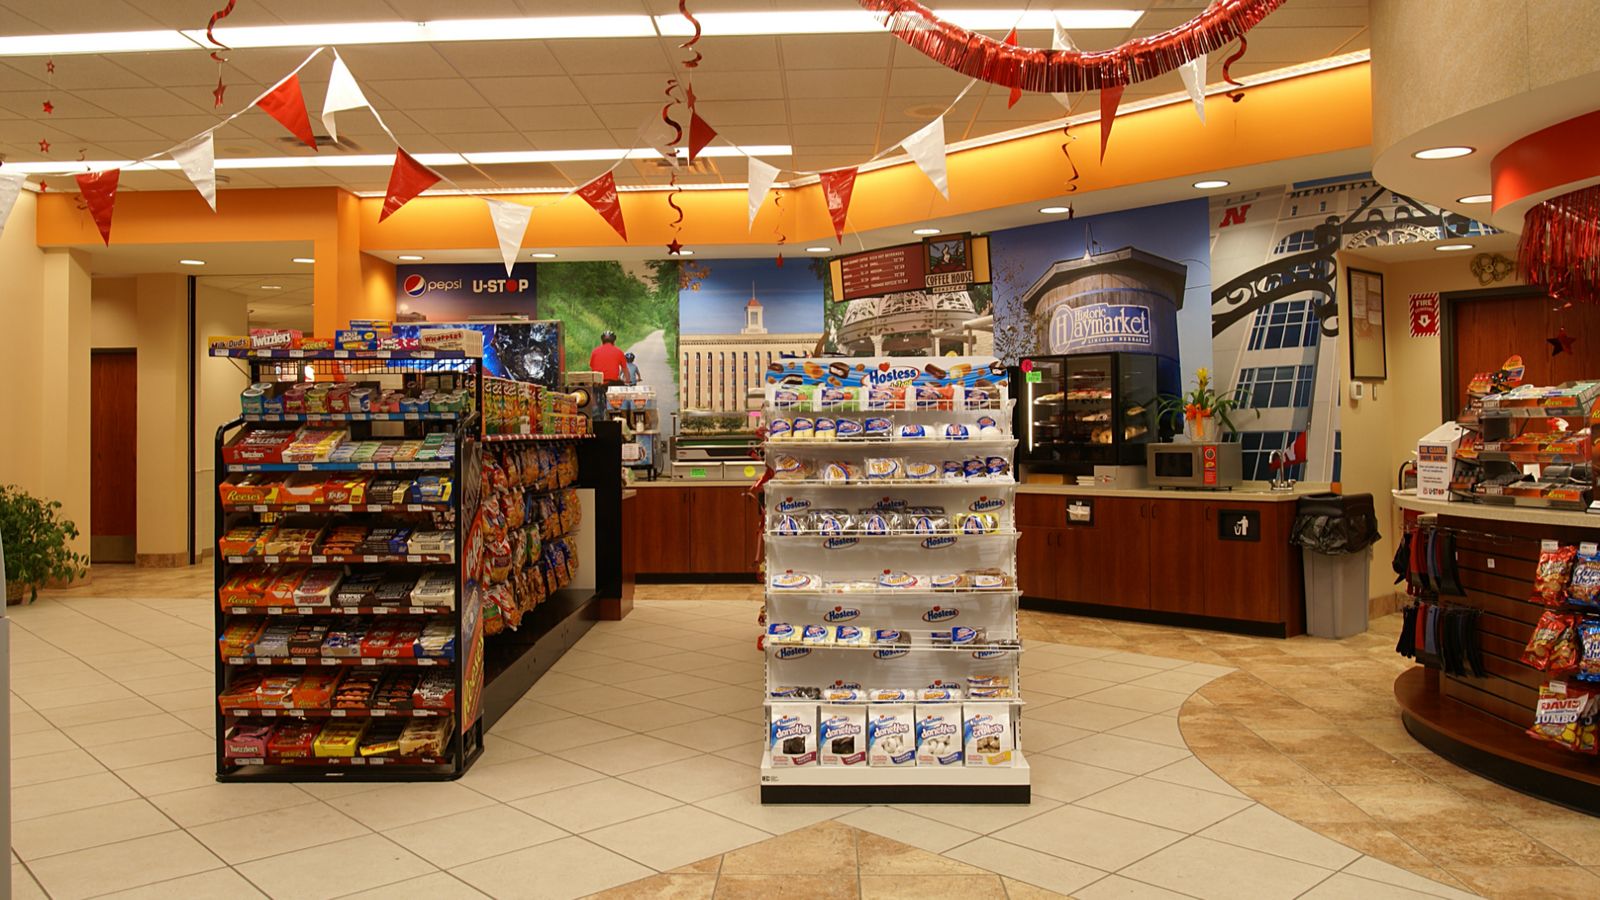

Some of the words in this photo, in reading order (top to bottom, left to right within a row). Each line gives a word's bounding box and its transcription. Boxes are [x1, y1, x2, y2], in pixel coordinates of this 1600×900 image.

[1290, 182, 1379, 199] MEMORIAL
[1219, 204, 1252, 228] N
[926, 273, 950, 286] COFFEE
[951, 271, 972, 283] HOUSE
[428, 279, 462, 292] pepsi
[472, 279, 528, 292] U-STOP
[1415, 299, 1433, 307] FIRE
[1075, 307, 1106, 321] Historic
[211, 341, 226, 349] Milk
[228, 339, 246, 348] Duds
[249, 331, 291, 347] Twizzlers
[869, 368, 916, 385] Hostess
[780, 500, 809, 512] Hostess
[974, 499, 1003, 511] Hostess
[926, 536, 955, 547] Hostess
[829, 609, 857, 621] Hostess
[927, 608, 955, 621] Hostess
[1534, 713, 1578, 725] JUMBO
[776, 723, 811, 738] donettes
[825, 723, 861, 738] donettes
[874, 723, 909, 738] donettes
[921, 723, 956, 738] donettes
